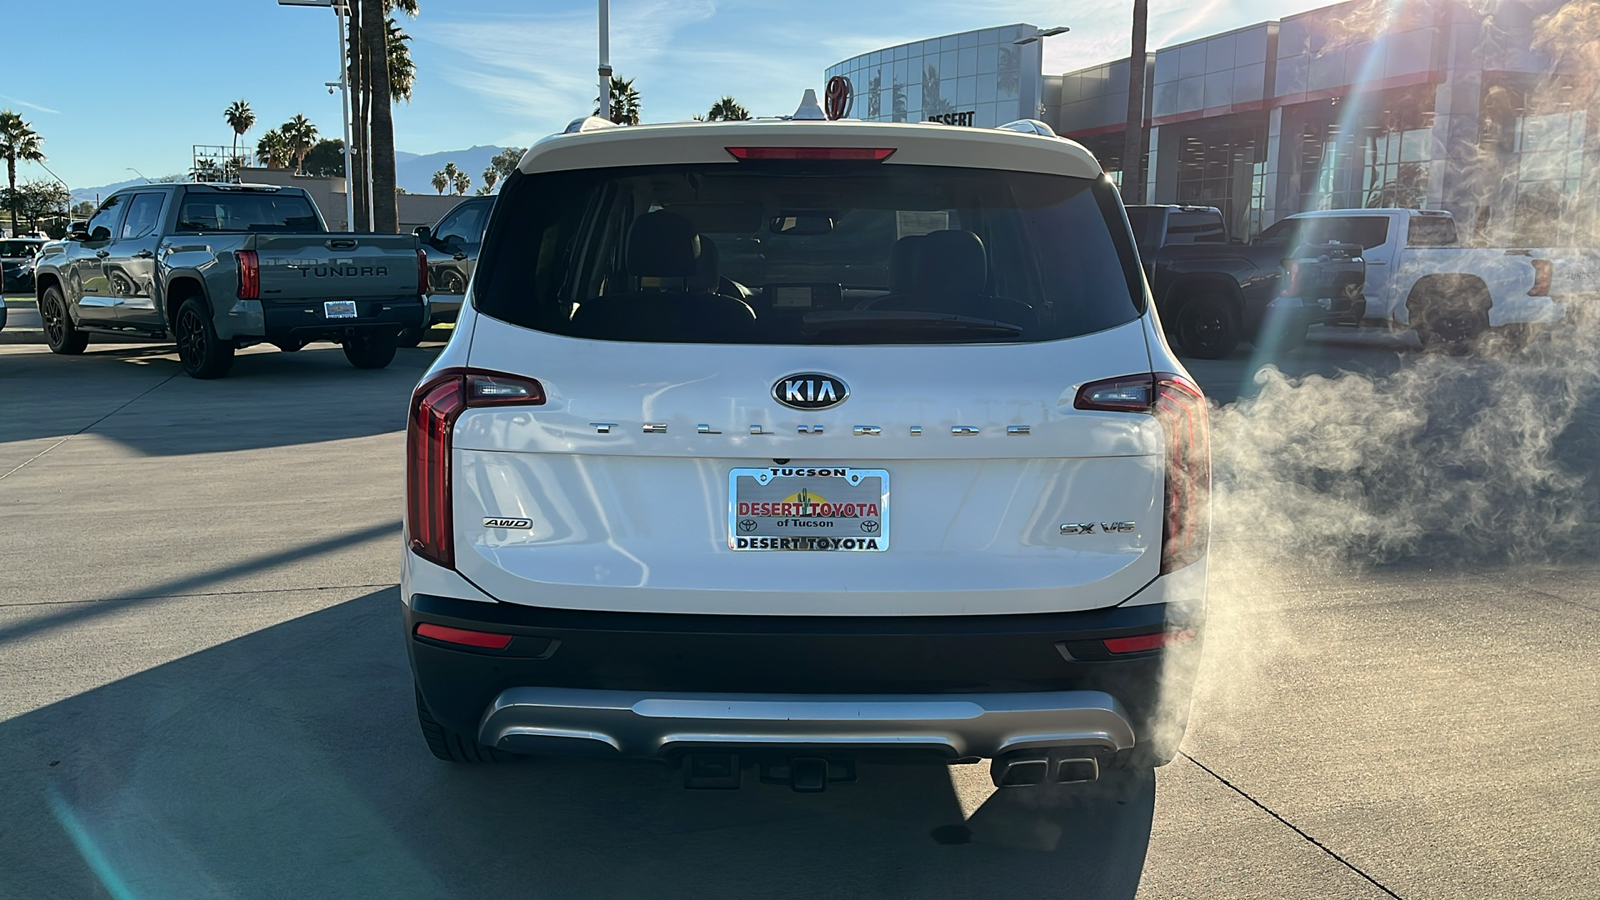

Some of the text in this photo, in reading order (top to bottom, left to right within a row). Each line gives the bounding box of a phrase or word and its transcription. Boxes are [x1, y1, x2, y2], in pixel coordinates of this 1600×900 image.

[300, 266, 388, 278] TUNDRA
[785, 380, 838, 402] KIA
[589, 422, 1031, 437] TELLURIDE
[770, 468, 847, 477] TUCSON
[738, 502, 879, 517] DESERT TOYOTA
[485, 519, 528, 527] AWD
[776, 519, 834, 528] of Tucson
[1060, 522, 1097, 536] SX
[737, 537, 879, 550] DESERT TOYOTA
